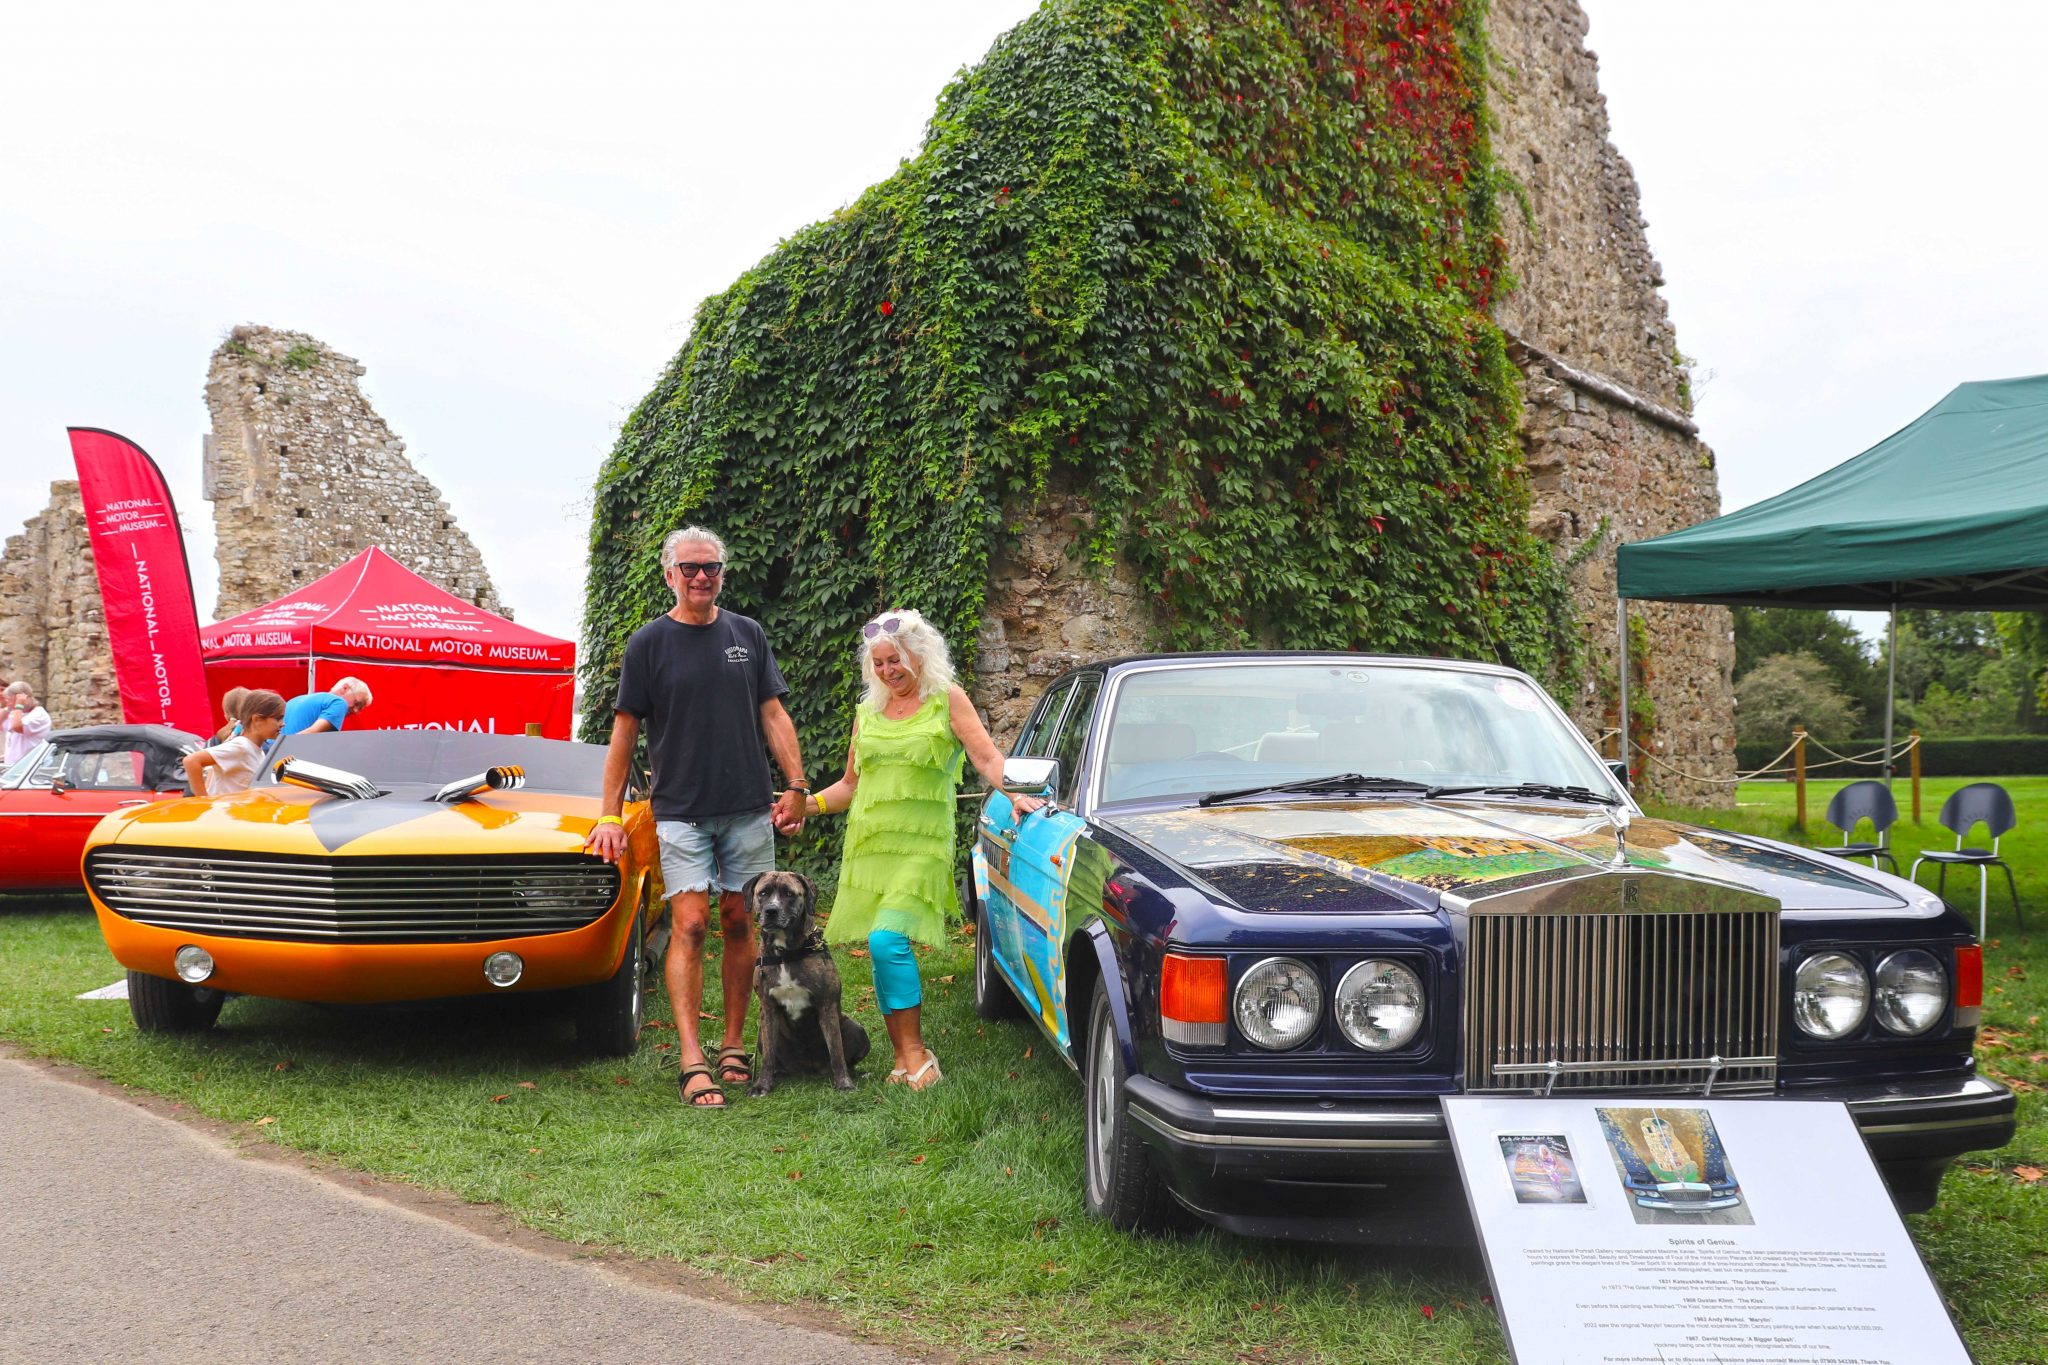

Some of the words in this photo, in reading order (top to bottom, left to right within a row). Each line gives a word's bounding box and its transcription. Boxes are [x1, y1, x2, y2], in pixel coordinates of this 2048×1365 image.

[106, 498, 153, 512] NATIONAL
[106, 511, 140, 524] MOTOR
[119, 521, 159, 533] MUSEUM
[376, 603, 460, 616] NATIONAL
[380, 612, 440, 622] MOTOR
[410, 622, 479, 632] MUSEUM
[136, 561, 159, 639] NATIONAL
[152, 653, 172, 708] MOTOR
[222, 634, 252, 648] MOTOR
[254, 632, 292, 646] MUSEUM
[344, 633, 422, 652] NATIONAL
[429, 640, 482, 657] MOTOR
[488, 646, 549, 661] MUSEUM
